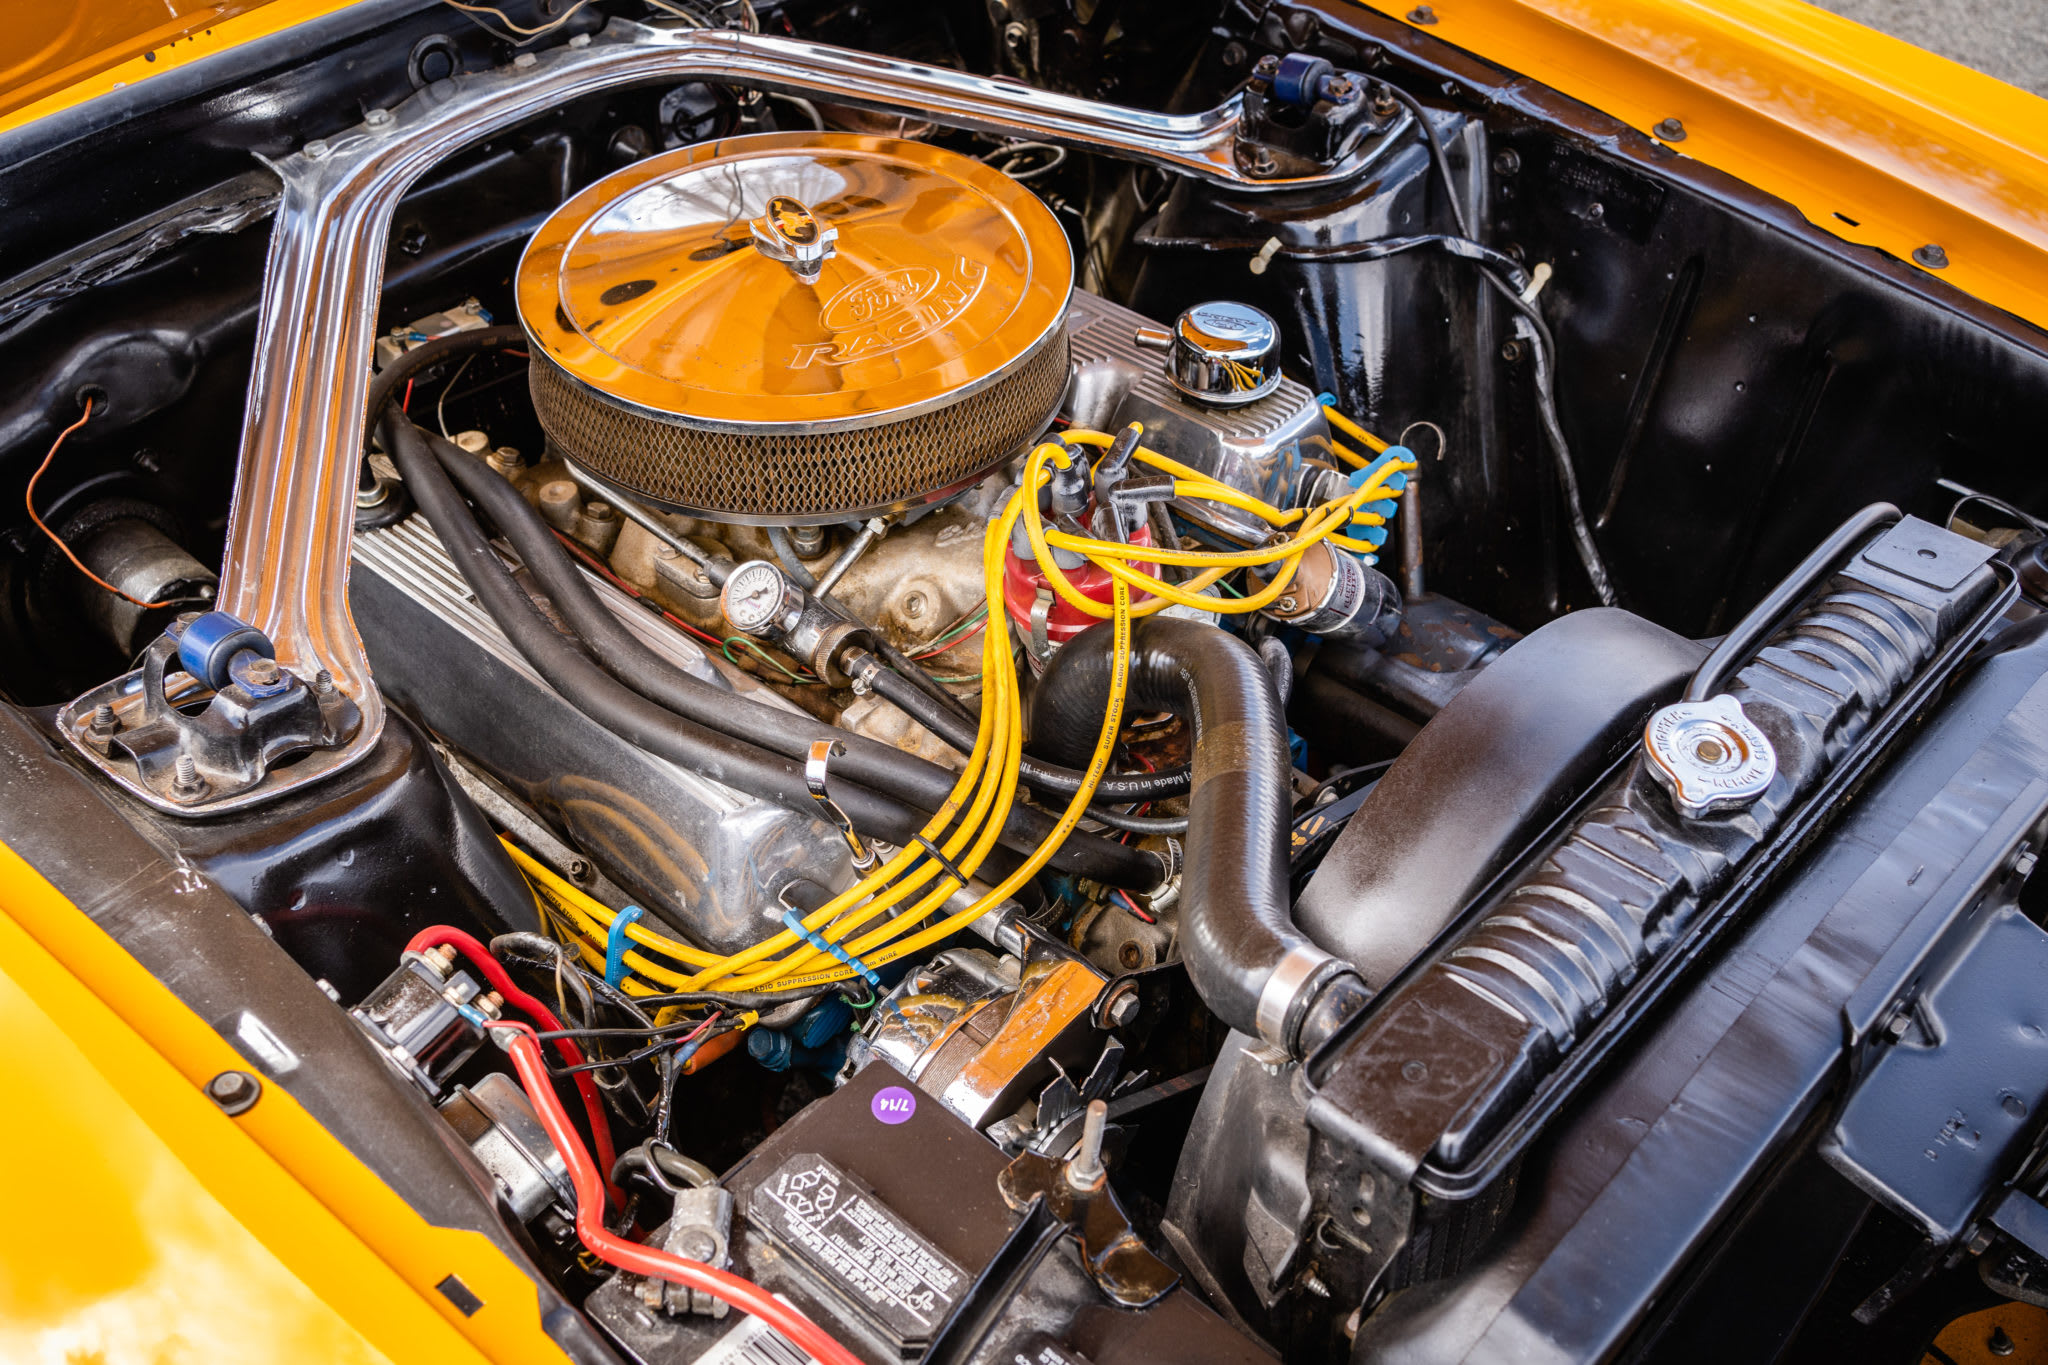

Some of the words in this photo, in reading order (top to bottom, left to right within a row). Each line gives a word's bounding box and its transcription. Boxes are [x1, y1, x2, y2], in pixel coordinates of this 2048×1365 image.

[849, 272, 920, 321] Ford
[790, 256, 988, 370] RACING
[1088, 758, 1104, 789] HI-TEMP
[1103, 725, 1114, 750] SUPER
[1111, 697, 1121, 722] STOCK
[1117, 663, 1125, 688] RADIO
[1141, 778, 1152, 789] in
[1154, 774, 1184, 787] Made
[545, 890, 562, 909] SUPER
[562, 908, 579, 926] STOCK
[776, 973, 831, 988] SUPPRESSION
[833, 968, 854, 978] CORE
[879, 951, 898, 962] WIRE
[880, 1098, 909, 1111] 7/14
[829, 1233, 871, 1268] IMMEDIATELY
[858, 1235, 877, 1251] FAST
[858, 1246, 874, 1260] GET
[874, 1249, 894, 1264] HELP
[868, 1264, 887, 1282] EYES
[884, 1278, 908, 1298] FLUSH
